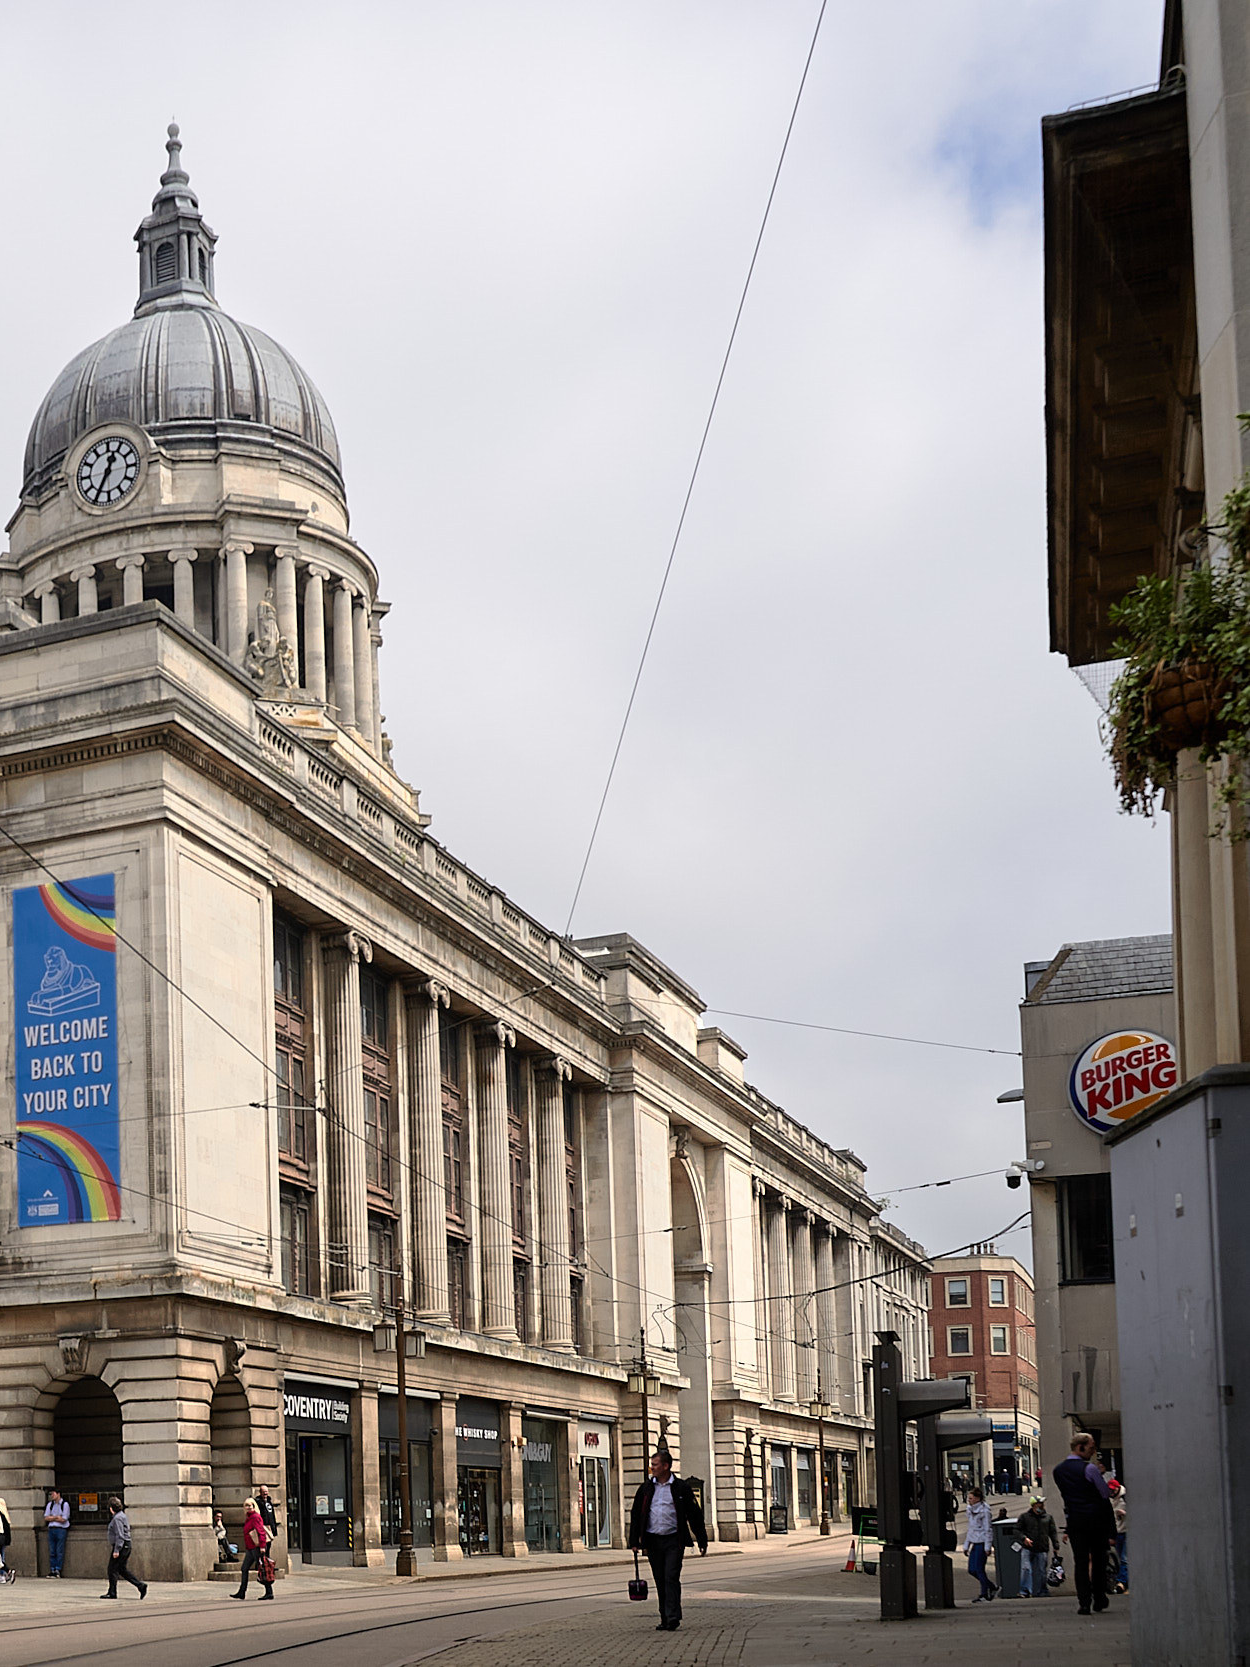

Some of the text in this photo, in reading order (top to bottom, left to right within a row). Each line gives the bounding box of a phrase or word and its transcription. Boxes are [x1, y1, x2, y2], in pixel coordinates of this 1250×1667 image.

[24, 1016, 108, 1047] WELCOME
[31, 1051, 102, 1080] BACK TO
[1081, 1043, 1170, 1091] BURGER
[23, 1083, 112, 1114] YOUR CITY
[1087, 1061, 1176, 1117] KING
[333, 1400, 349, 1413] Building
[334, 1411, 348, 1423] Society
[463, 1427, 483, 1439] WHISKY
[484, 1430, 498, 1440] SHOP
[521, 1441, 551, 1462] ONI&GUY
